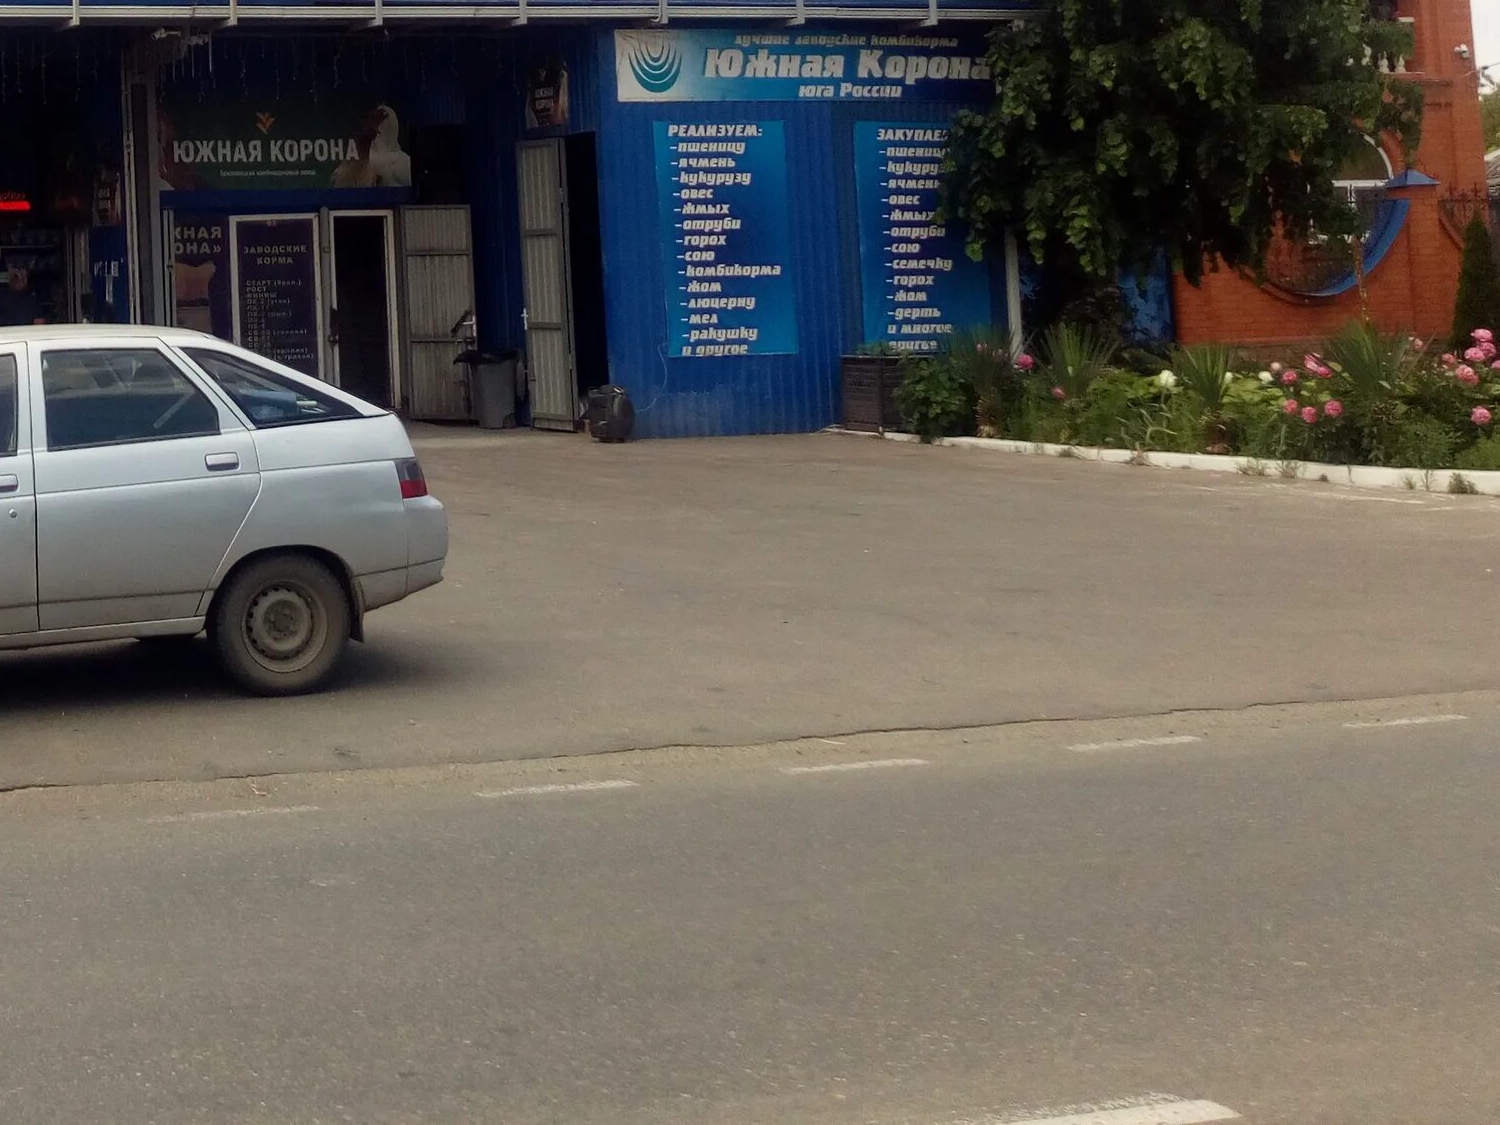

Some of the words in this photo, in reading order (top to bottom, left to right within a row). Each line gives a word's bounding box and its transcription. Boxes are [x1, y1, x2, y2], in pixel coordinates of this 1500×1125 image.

[735, 35, 790, 46] лучшие
[795, 35, 865, 46] заводские
[871, 35, 958, 47] комбикорма
[705, 49, 844, 78] Южная
[859, 49, 990, 84] Корона
[799, 84, 834, 97] юга
[840, 83, 903, 97] России
[668, 125, 763, 136] РЕАЛИЗУЕМ:
[173, 140, 261, 163] ЮЖНАЯ
[270, 138, 359, 162] КОРОНА
[879, 161, 944, 175] -кукуру
[175, 226, 222, 239] НАЯ
[174, 242, 222, 254] ОНА»
[244, 245, 307, 255] ЗАВОДСКИЕ
[257, 257, 293, 265] КОРМА
